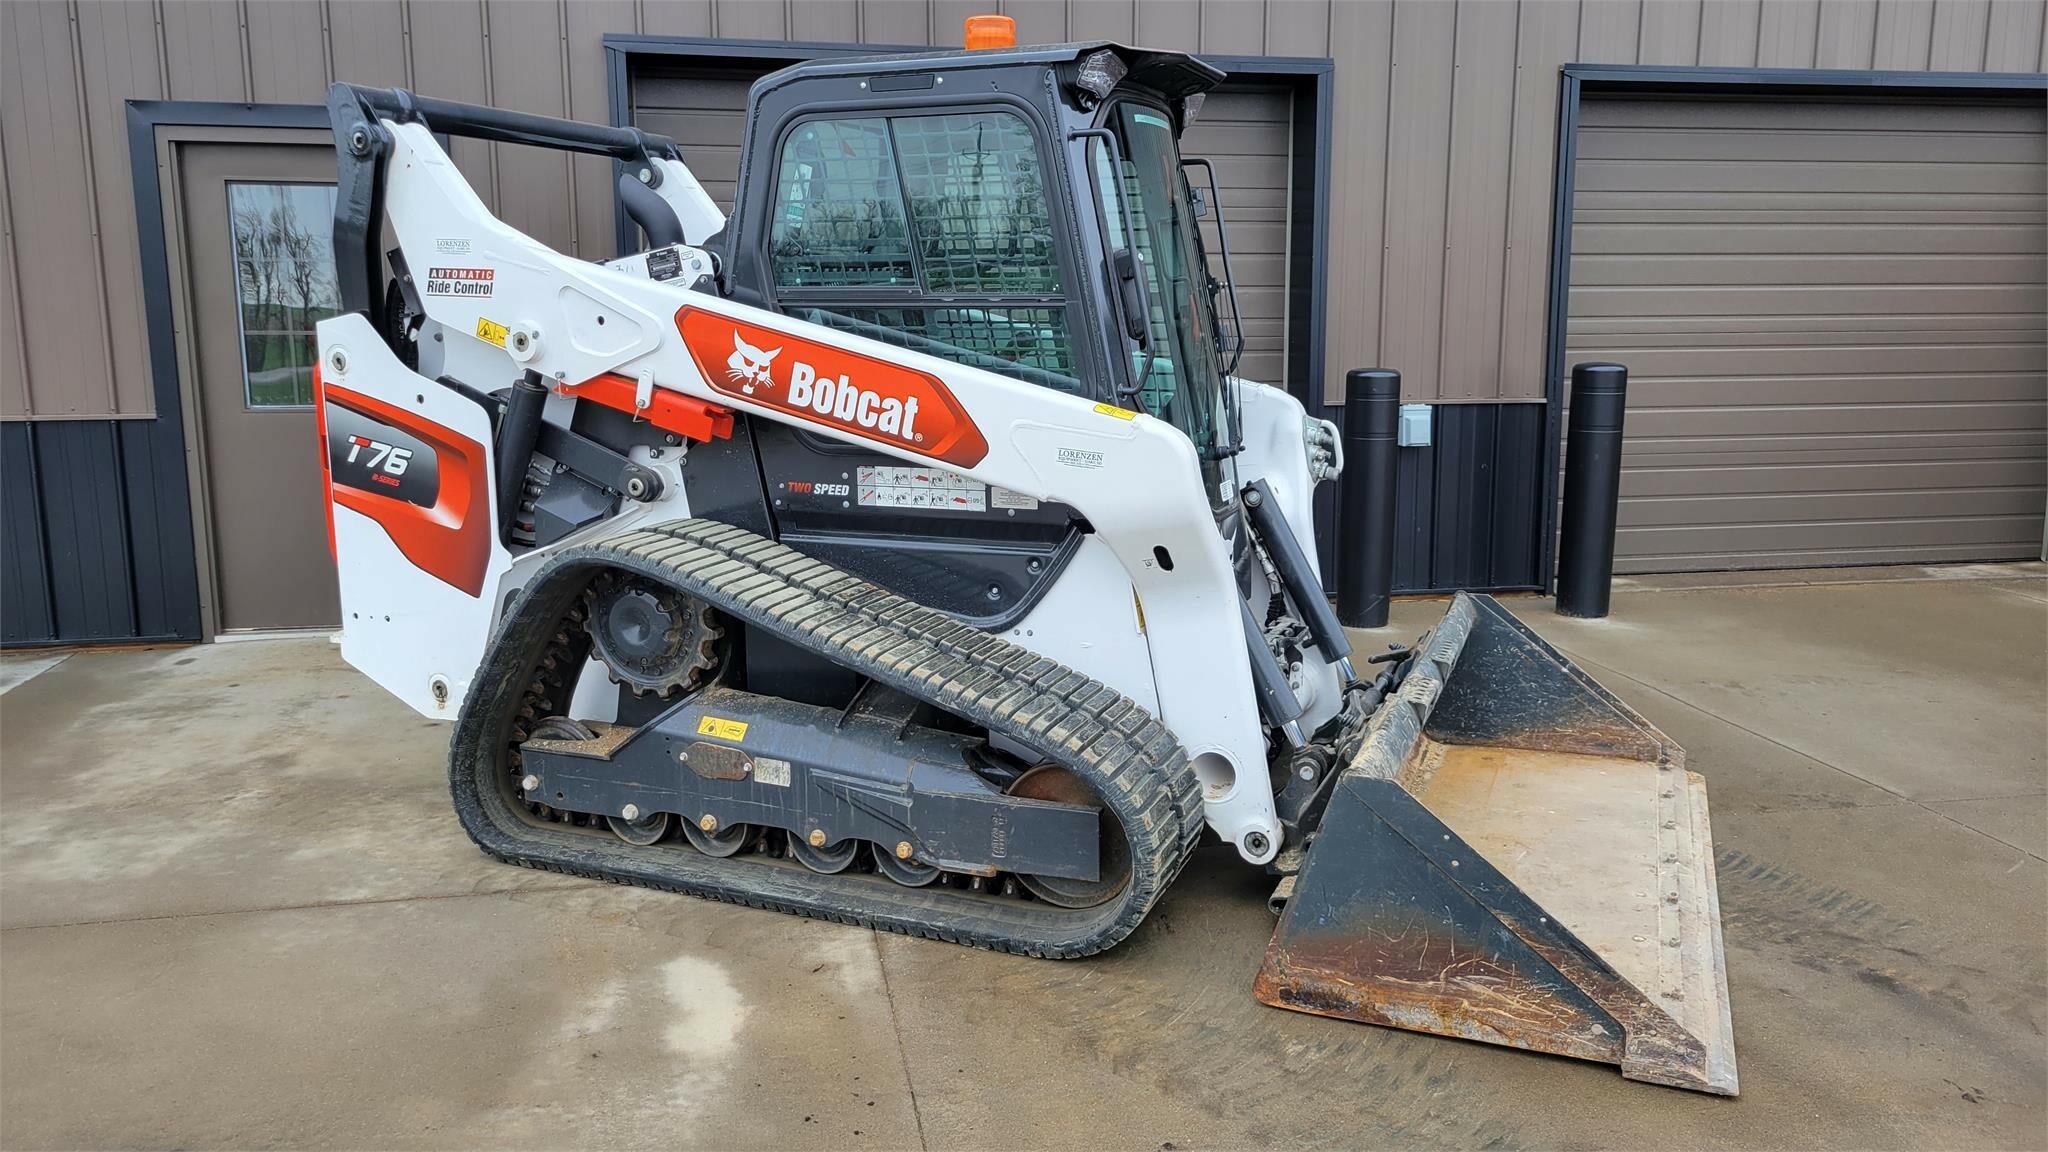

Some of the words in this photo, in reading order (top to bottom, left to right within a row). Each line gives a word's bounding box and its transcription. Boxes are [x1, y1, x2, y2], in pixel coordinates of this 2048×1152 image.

[436, 240, 471, 248] LORENZEN
[430, 269, 493, 280] AUTOMATIC
[426, 280, 451, 294] Ride
[453, 281, 494, 295] Control
[787, 361, 919, 440] Bobcat
[346, 435, 413, 476] T76
[1058, 449, 1103, 461] LORENZEN
[788, 481, 812, 494] TWO
[813, 483, 850, 496] SPEED
